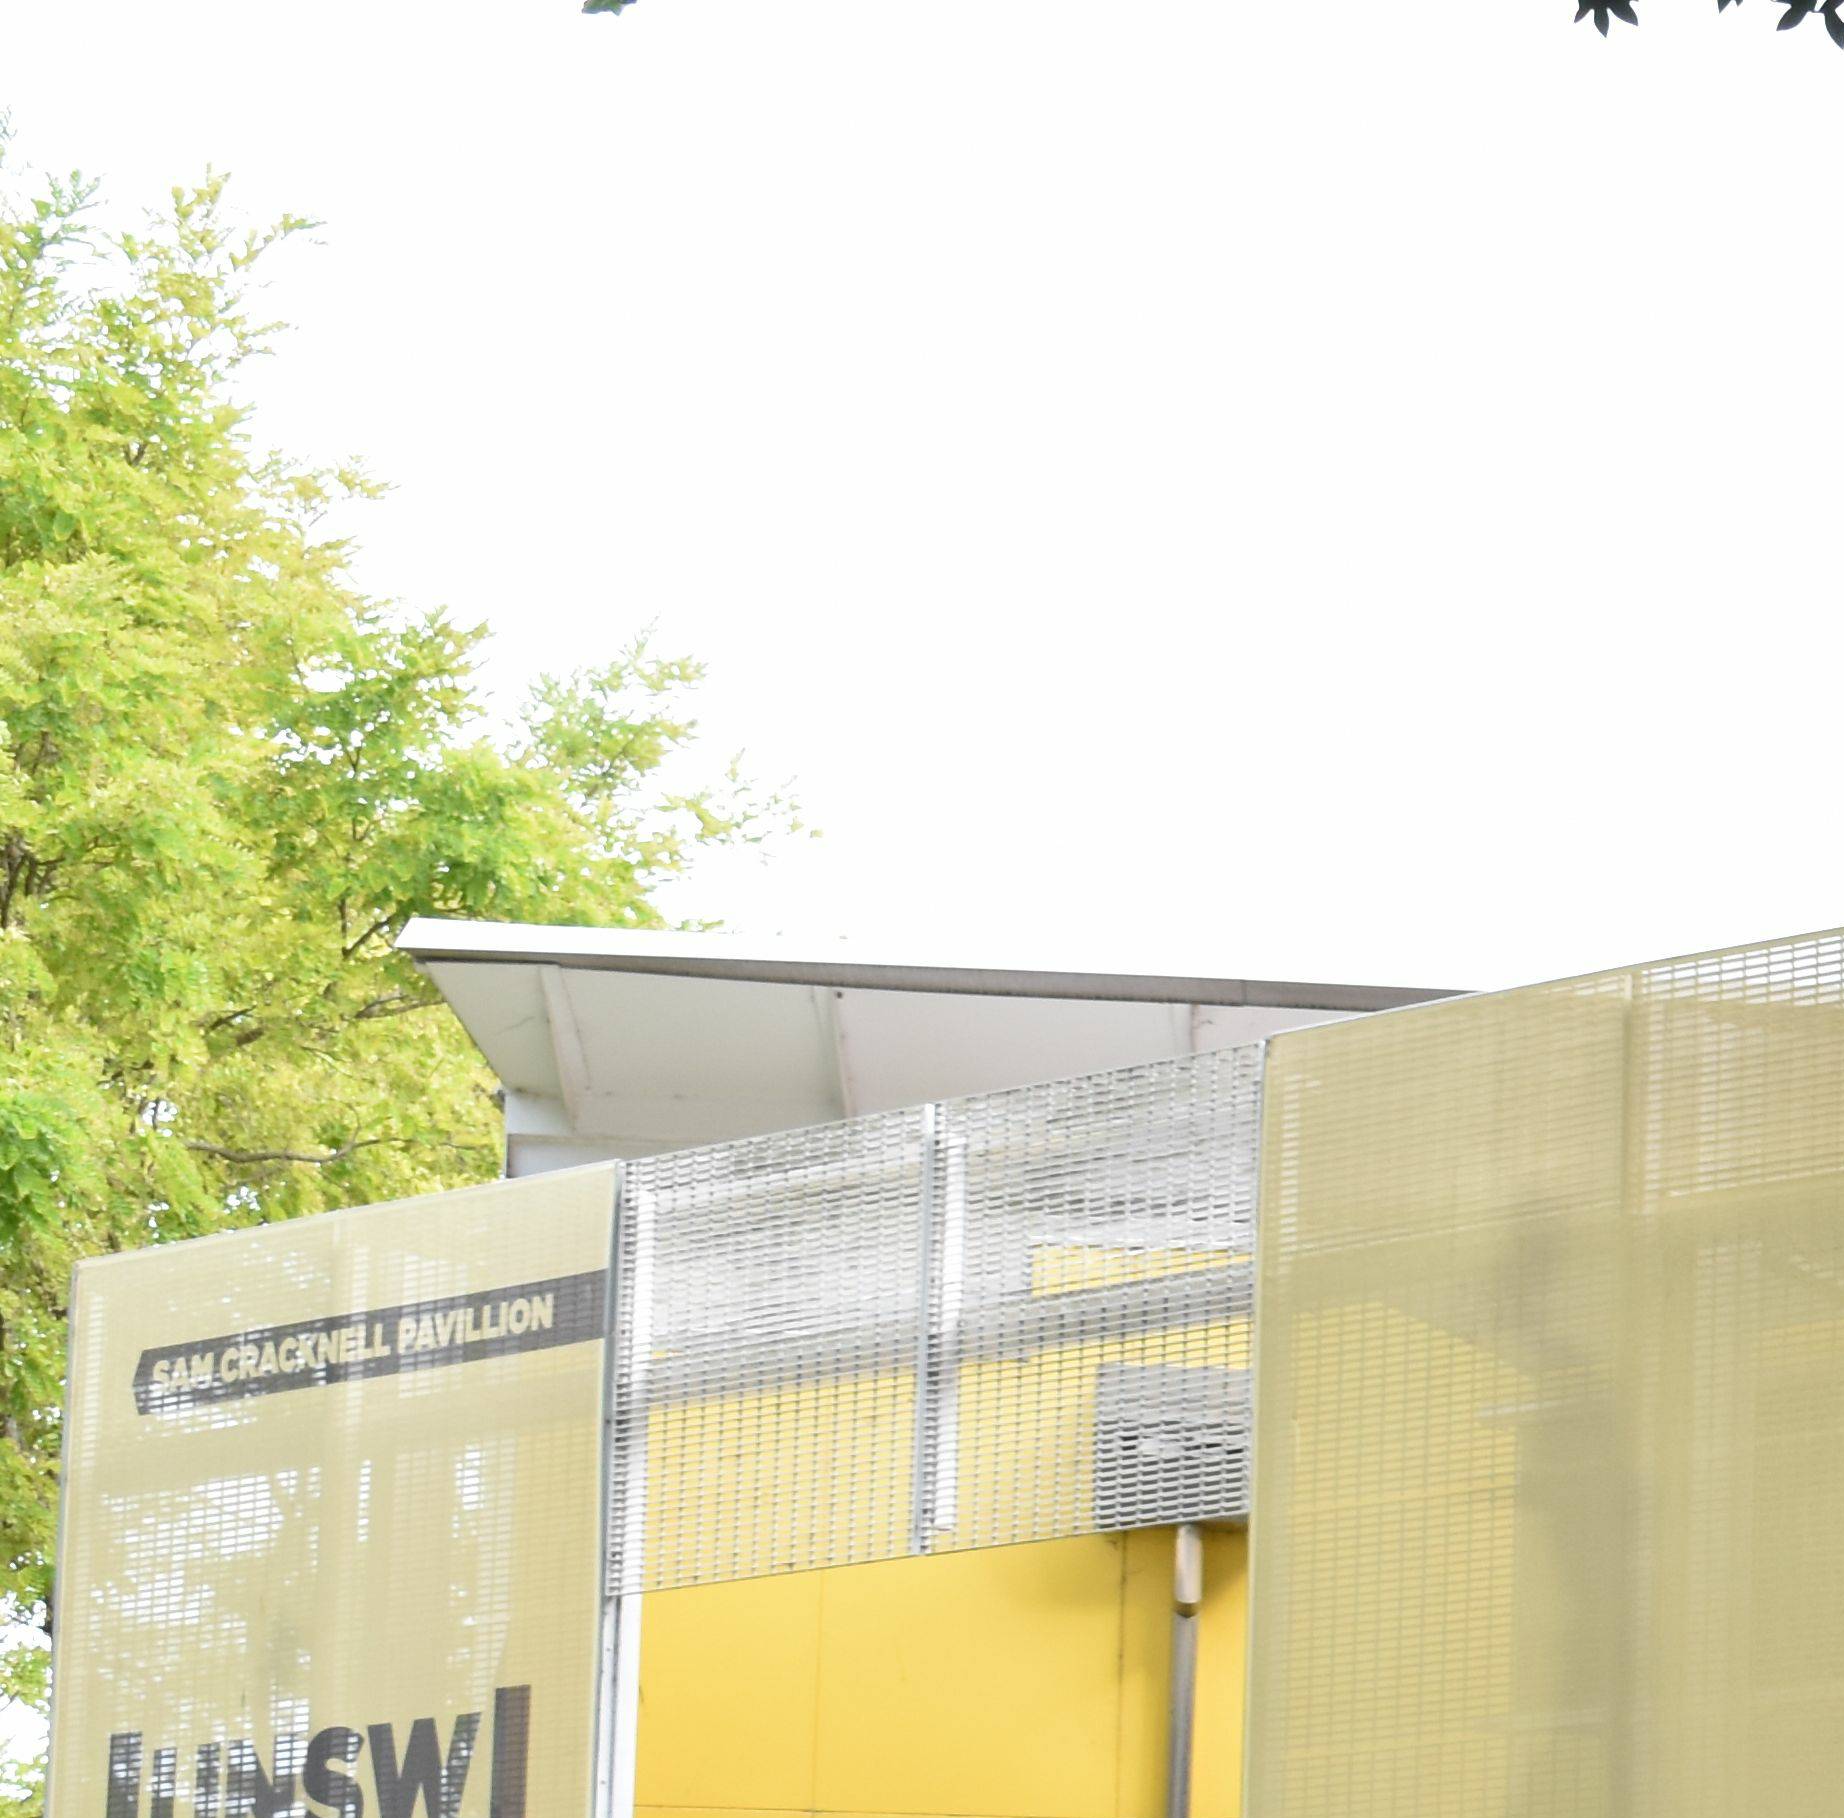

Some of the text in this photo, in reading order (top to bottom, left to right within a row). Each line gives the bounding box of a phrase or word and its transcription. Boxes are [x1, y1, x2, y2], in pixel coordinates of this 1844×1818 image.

[153, 1294, 554, 1396] SAM CRACKNELL PAVILLION
